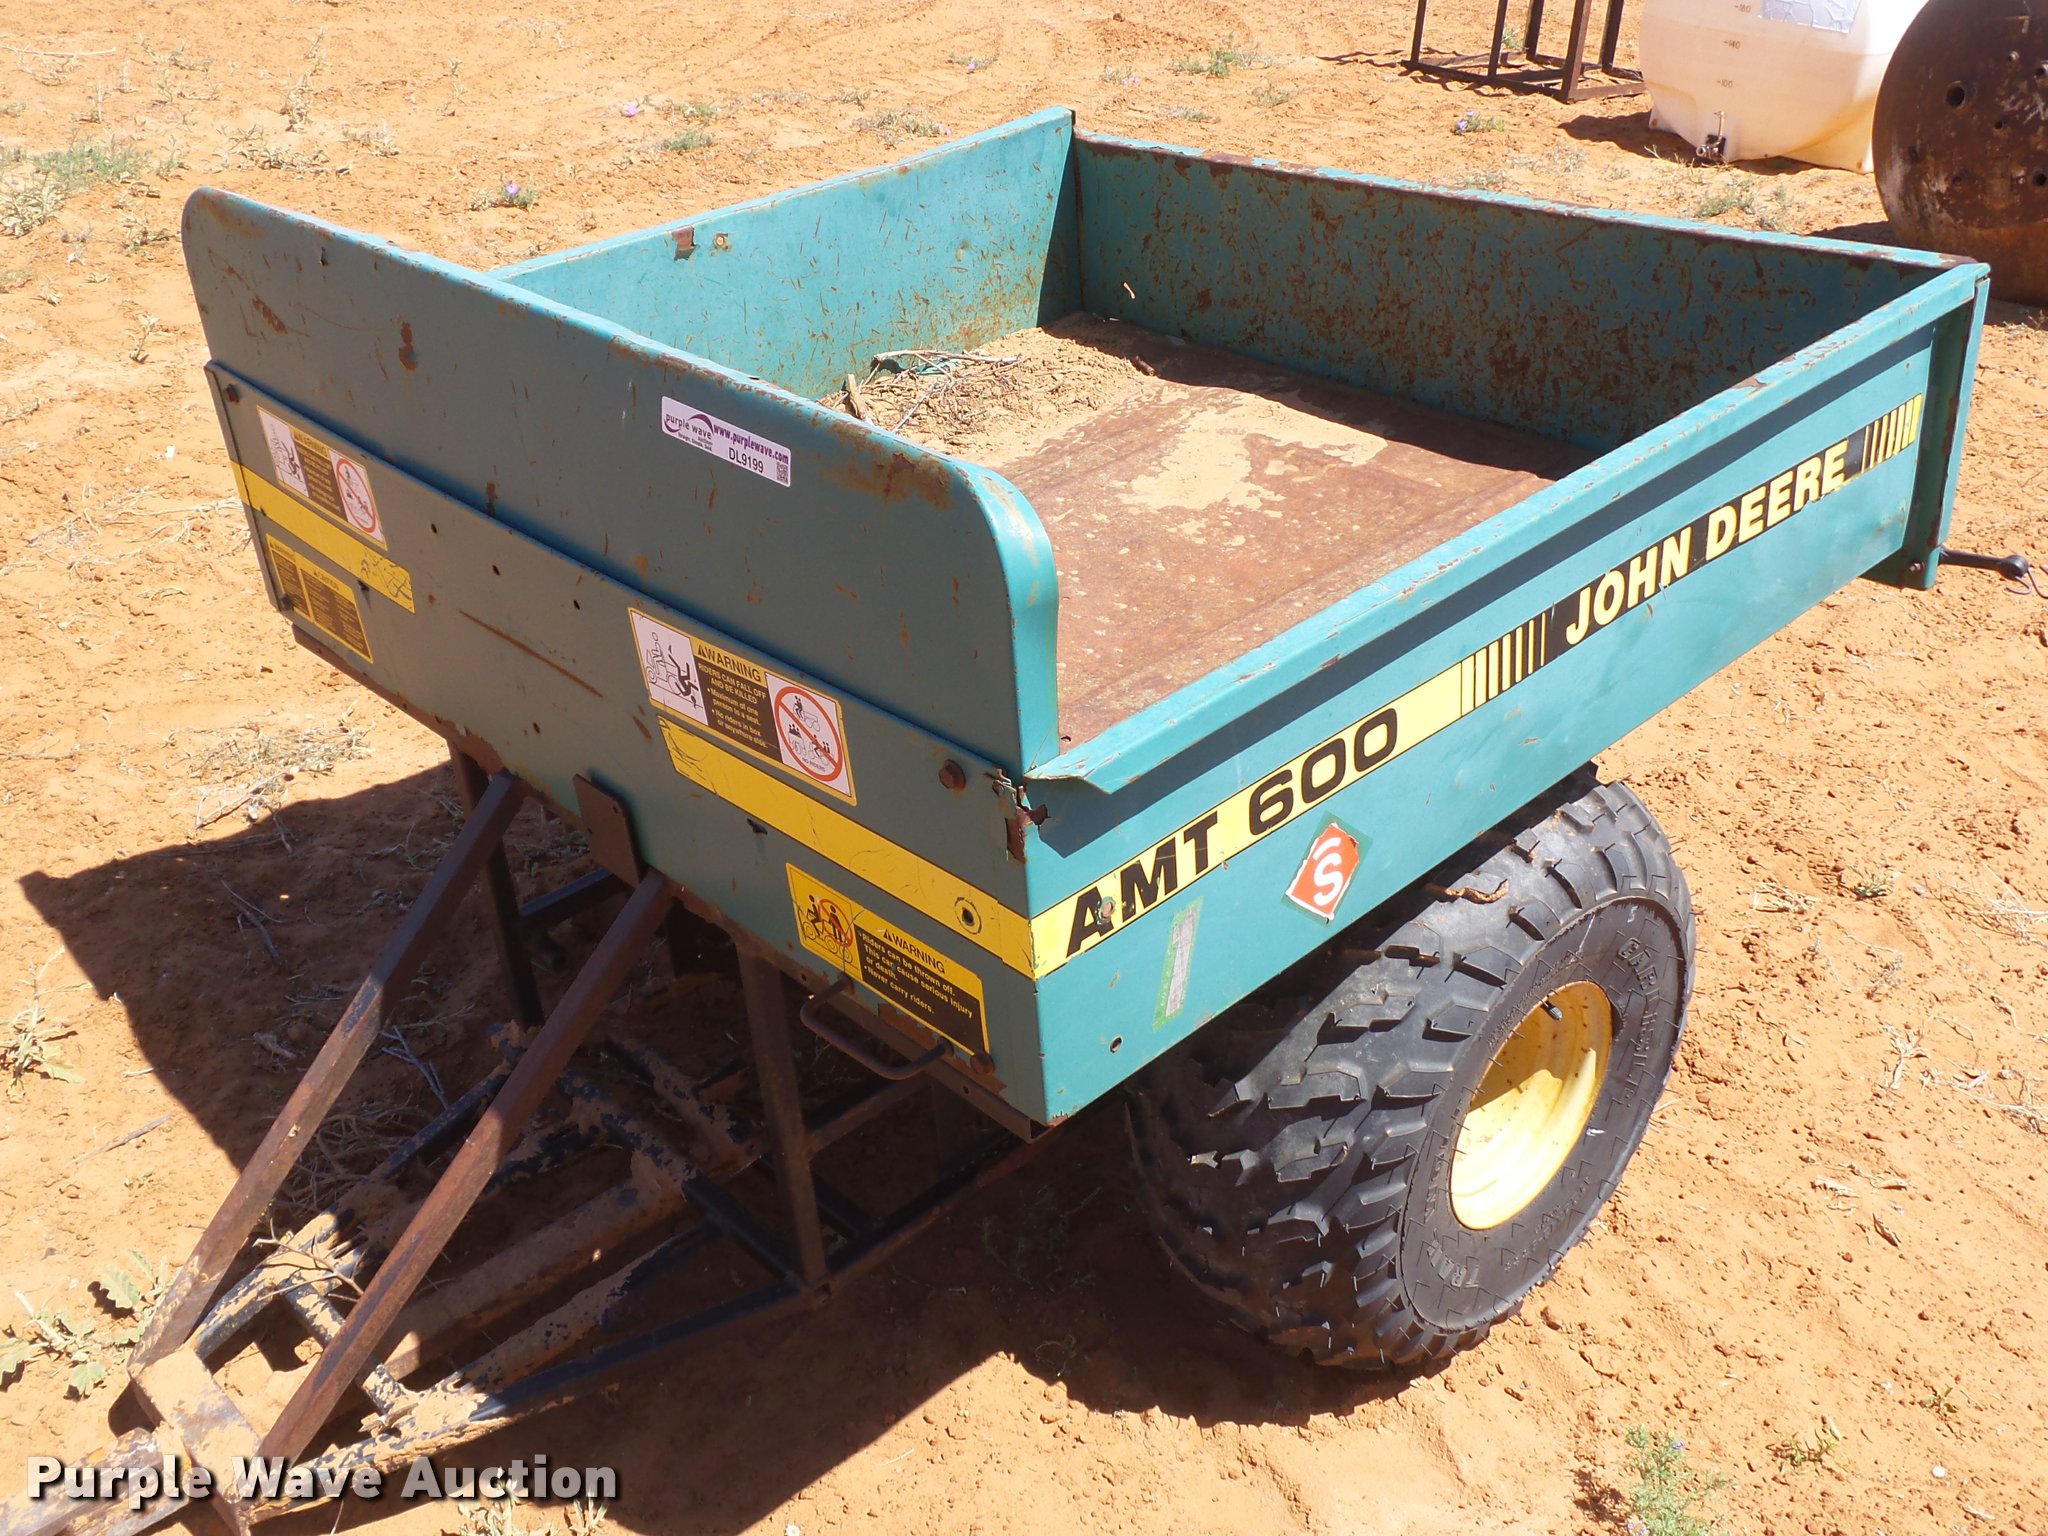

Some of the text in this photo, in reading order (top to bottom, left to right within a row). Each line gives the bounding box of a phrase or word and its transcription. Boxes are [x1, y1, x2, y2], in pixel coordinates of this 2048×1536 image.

[665, 413, 712, 440] purple wave
[713, 424, 789, 465] www.purplewave.com
[728, 447, 764, 473] DL9199
[1565, 439, 1849, 646] JOHN DEERE
[698, 662, 767, 699] RIDERS CAN FALL OFF
[705, 646, 761, 682] WARNING
[710, 687, 759, 716] Maximum of one
[711, 678, 758, 704] AND BE KILLED
[713, 698, 732, 714] person
[733, 707, 740, 716] to
[725, 714, 742, 728] riders
[742, 722, 749, 731] in
[725, 723, 753, 741] anywhere
[1066, 707, 1398, 958] AMT 600
[862, 933, 956, 997] Riders can be thrown off.
[865, 957, 898, 981] or death.
[892, 932, 946, 974] WARNING
[863, 944, 880, 960] This
[896, 966, 919, 984] cause
[920, 980, 948, 1003] serious
[950, 997, 973, 1019] injury
[868, 965, 935, 1014] Never carry riders.
[1425, 1228, 1480, 1289] TRAIL
